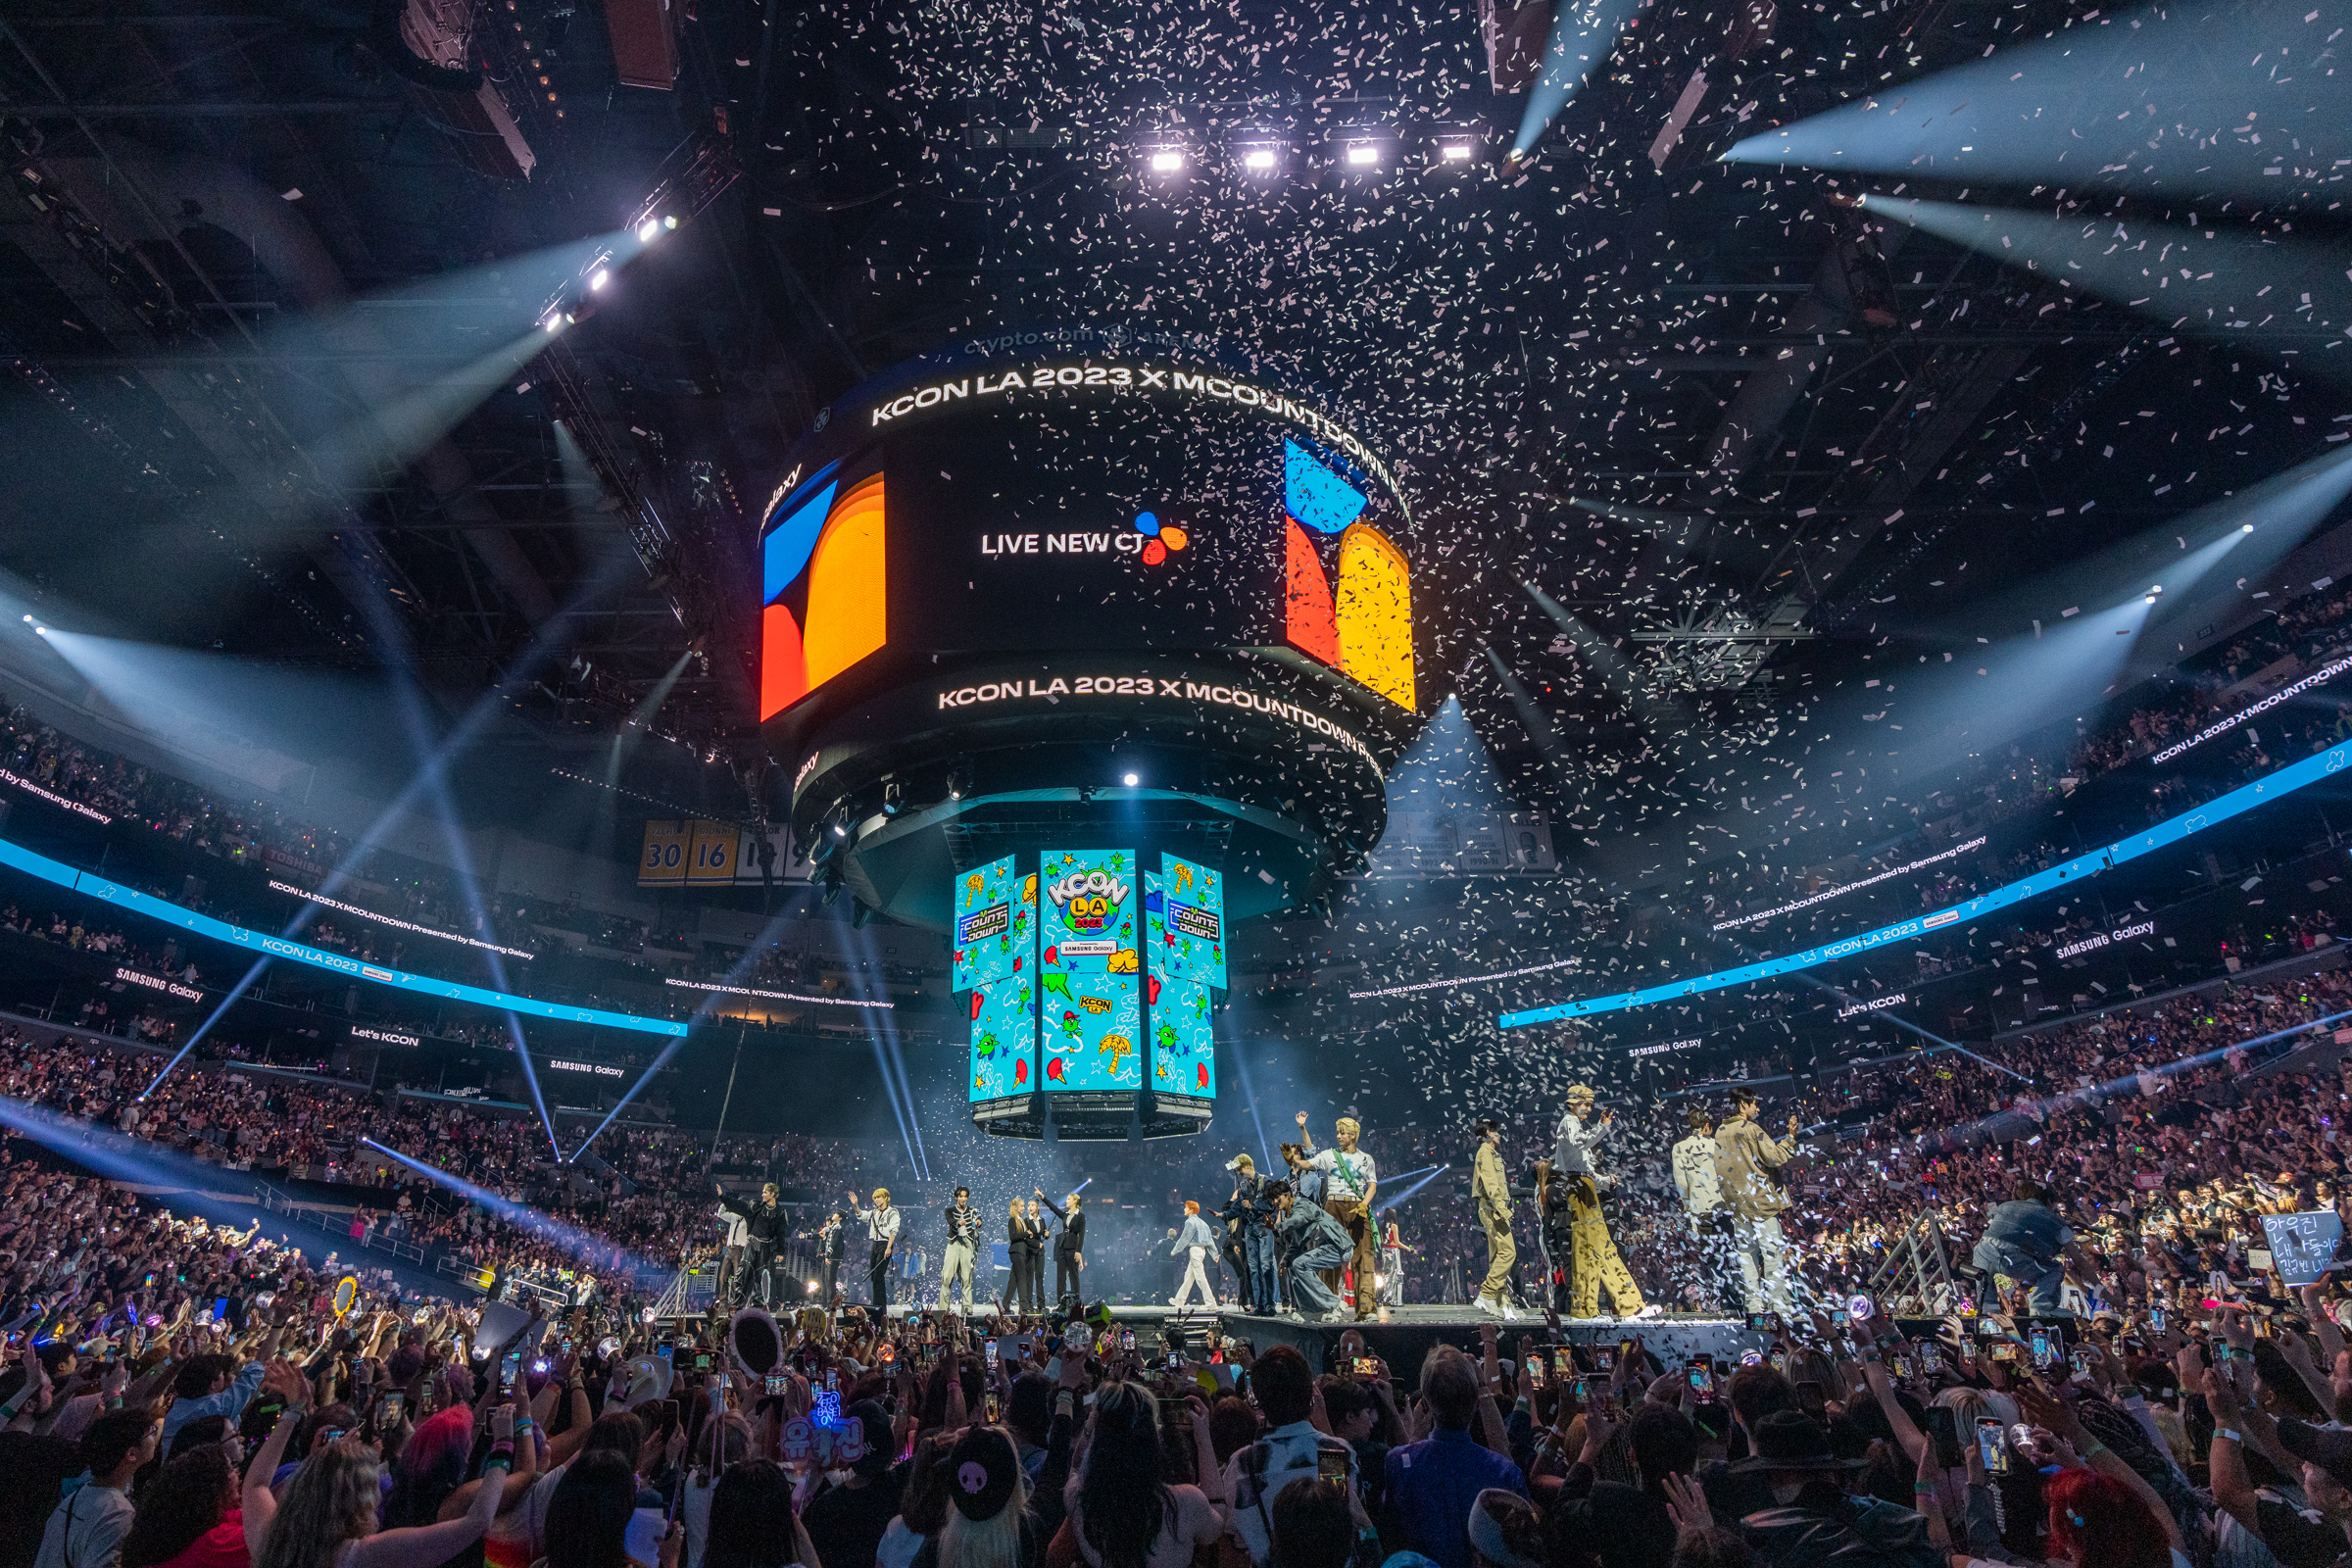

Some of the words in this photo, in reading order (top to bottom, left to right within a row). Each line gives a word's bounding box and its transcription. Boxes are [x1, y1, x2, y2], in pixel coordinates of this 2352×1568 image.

[964, 327, 1094, 355] crypto.com
[872, 380, 968, 426] KCON
[977, 371, 1026, 394] LA
[1032, 368, 1132, 386] 2023
[1139, 368, 1167, 388] X
[982, 534, 1039, 554] LIVE
[1047, 533, 1110, 553] NEW
[1114, 533, 1145, 554] CJ
[939, 681, 1022, 709] KCON
[1029, 678, 1070, 696] LA
[1074, 677, 1154, 695] 2023
[1159, 679, 1182, 697] X
[1186, 682, 1356, 752] MCOUNTDOWN
[2152, 742, 2187, 764] KCON
[2185, 734, 2205, 748] LA
[2202, 718, 2236, 739] 2023
[2234, 710, 2248, 723] X
[5, 771, 21, 785] by
[20, 778, 73, 808] Samsung
[73, 802, 112, 824] Galaxy
[270, 849, 322, 875] TOSHIBA
[646, 843, 683, 868] 30
[698, 843, 726, 869] 16
[1048, 871, 1130, 907] KCON
[1713, 919, 1740, 932] KCON
[1740, 915, 1752, 924] LA
[1752, 909, 1776, 921] 2023
[1785, 884, 1852, 911] MCOUNTDOWN
[1851, 868, 1897, 890] Presented
[1897, 863, 1910, 874] by
[1910, 849, 1956, 870] Samsung
[1956, 836, 1986, 854] Galaxy
[1075, 900, 1104, 912] LA
[1174, 908, 1214, 927] COUNT
[270, 880, 299, 895] KCON
[298, 890, 312, 900] LA
[312, 894, 336, 907] 2023
[344, 906, 412, 930] MCOUNTDOWN
[412, 924, 459, 941] Presented
[458, 935, 468, 945] by
[468, 939, 508, 955] Samsung
[508, 948, 534, 960] Galaxy
[964, 911, 1004, 931] COUNT
[1074, 918, 1102, 928] 2023
[1179, 922, 1210, 939] DOWN
[968, 925, 999, 942] DOWN
[1824, 940, 1861, 957] KCON
[1861, 934, 1882, 947] LA
[1882, 922, 1918, 941] 2023
[2056, 934, 2110, 958] SAMSUNG
[2113, 921, 2154, 941] Galaxy
[262, 939, 304, 957] KCON
[305, 951, 323, 962] LA
[324, 956, 358, 972] 2023
[116, 967, 167, 991] SAMSUNG
[169, 983, 204, 1004] Galaxy
[1409, 978, 1468, 991] MCOUNTDOWN
[1468, 971, 1507, 983] Presented
[1518, 964, 1553, 975] Samsung
[665, 978, 688, 987] KCON
[787, 994, 824, 1004] Presented
[835, 998, 869, 1007] Samsung
[869, 1001, 895, 1009] Galaxy
[1080, 996, 1111, 1012] KCON
[1868, 993, 1907, 1010] KCON
[381, 1032, 419, 1047] KCON
[550, 1059, 593, 1072] SAMSUNG
[595, 1065, 624, 1078] Galaxy
[816, 1394, 837, 1407] ZERO
[817, 1405, 838, 1417] BASE
